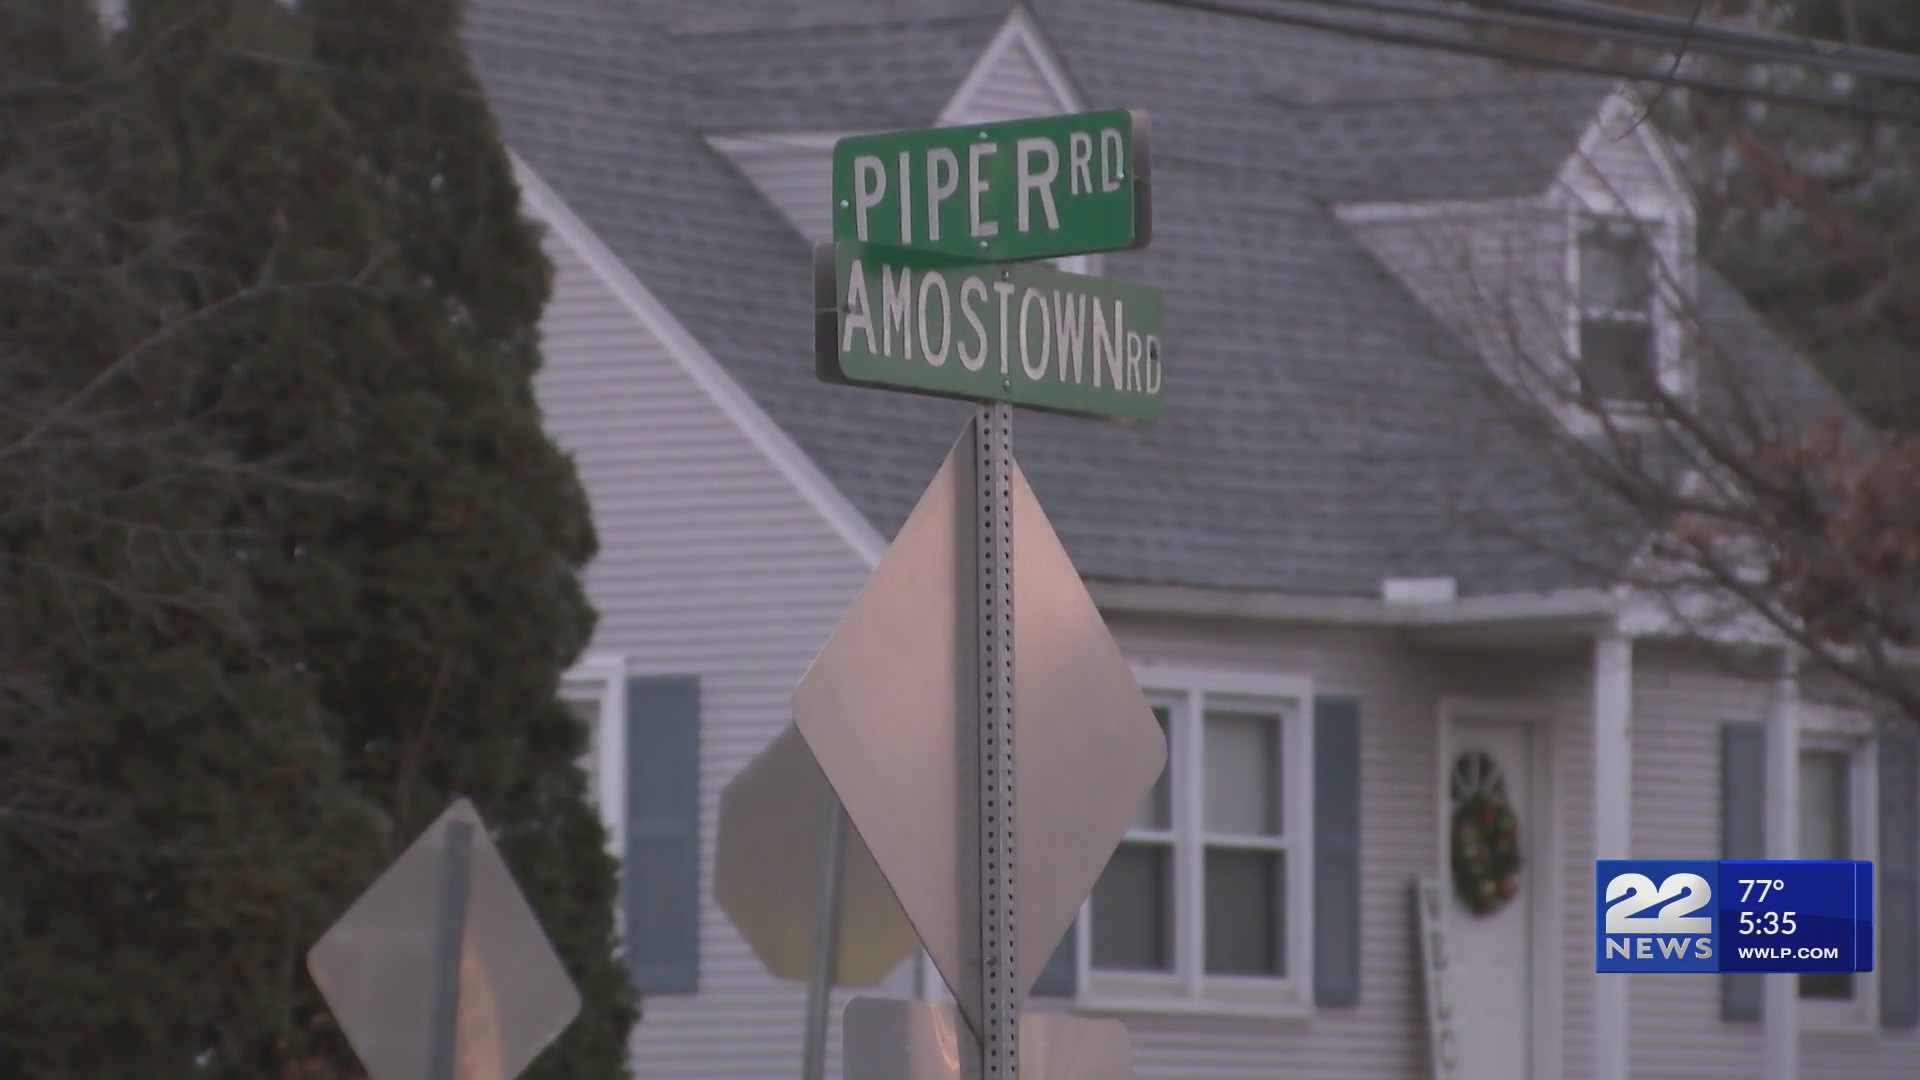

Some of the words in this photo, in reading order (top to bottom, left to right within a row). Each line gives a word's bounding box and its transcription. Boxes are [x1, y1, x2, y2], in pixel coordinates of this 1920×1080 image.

[854, 138, 1060, 243] PIPER
[1070, 129, 1124, 195] RD
[842, 260, 1123, 390] AMOSTOWN
[1126, 332, 1162, 394] RD
